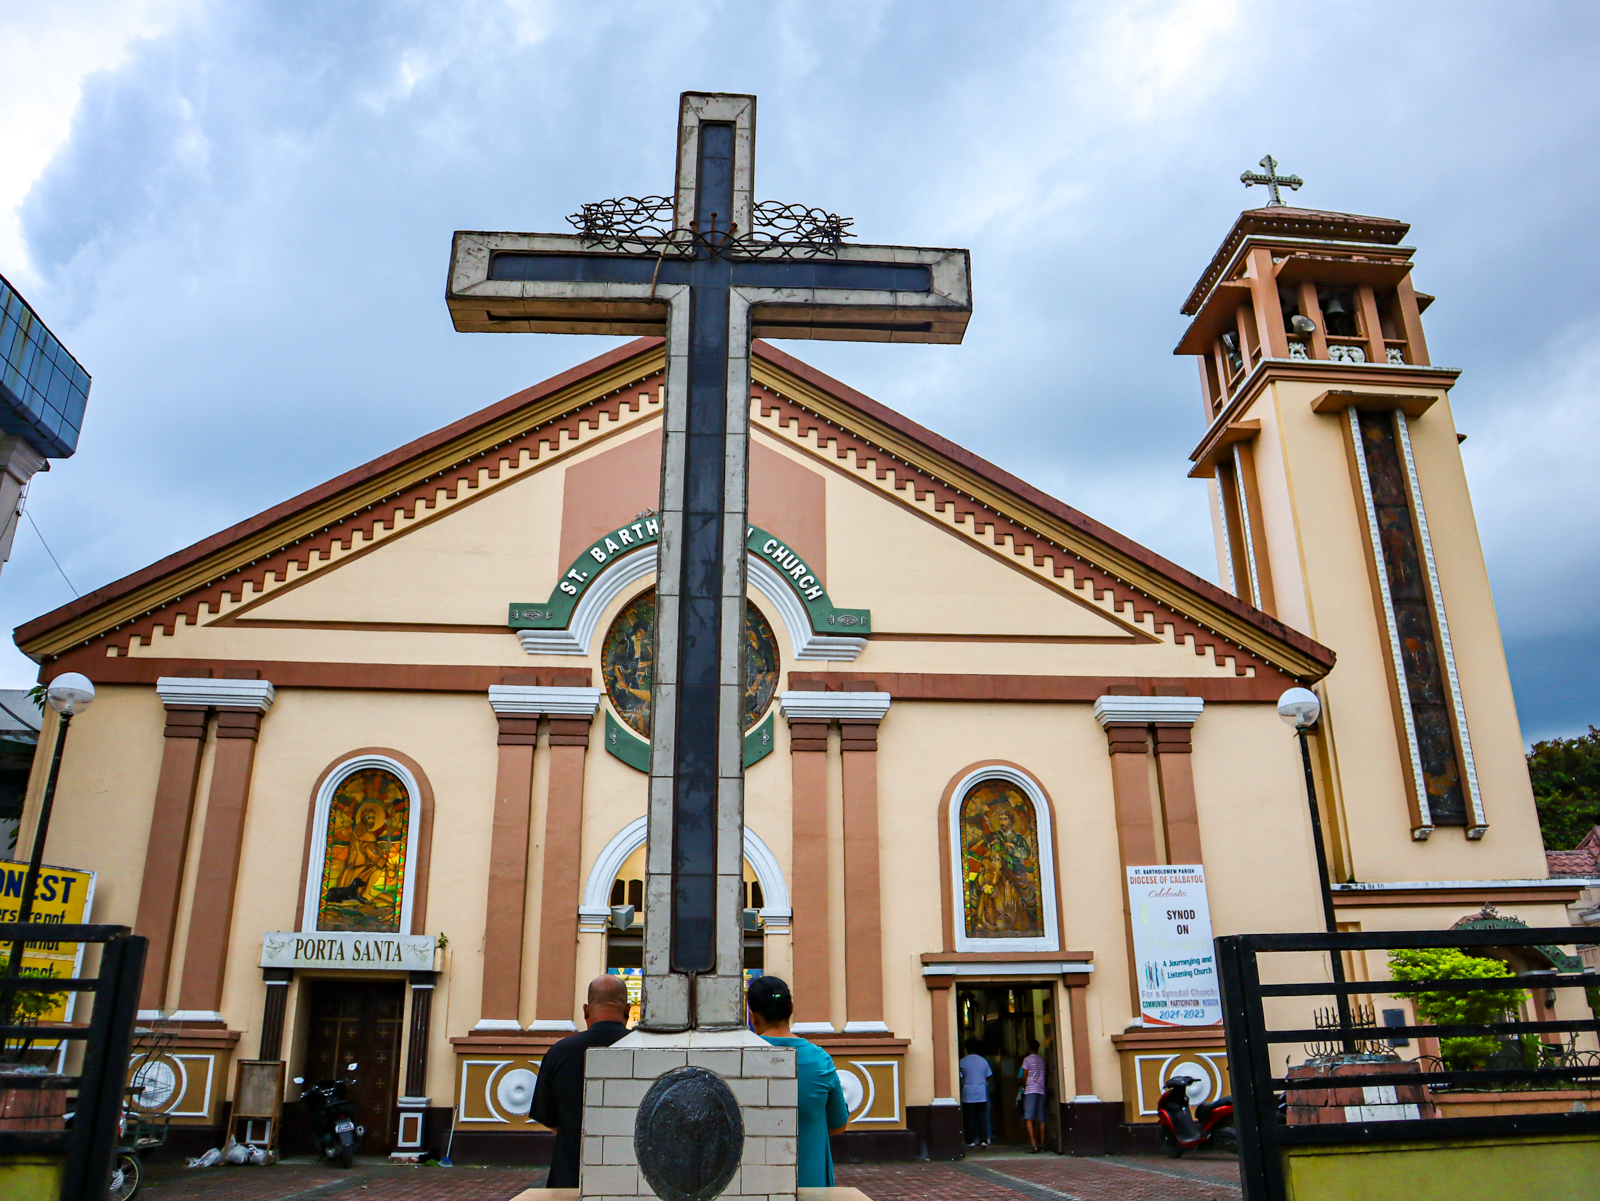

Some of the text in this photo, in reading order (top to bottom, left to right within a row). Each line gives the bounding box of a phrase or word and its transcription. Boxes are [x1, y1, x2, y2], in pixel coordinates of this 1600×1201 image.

[560, 568, 588, 596] ST.
[762, 538, 824, 602] CHURCH
[1130, 874, 1204, 885] DIOCESE OF CALBAYOG
[1148, 887, 1188, 898] Celebrates
[1166, 909, 1196, 921] SYNOD
[1176, 924, 1190, 935] ON
[293, 938, 403, 962] PORTA SANTA
[1162, 955, 1212, 968] A Journeying and
[1167, 967, 1213, 979] Listening Church
[1141, 990, 1154, 999] For
[1161, 989, 1189, 1000] Synodal
[1142, 998, 1219, 1009] COMMUNION PARTICIPATION MISSION
[1159, 1008, 1205, 1020] 2021-2023
